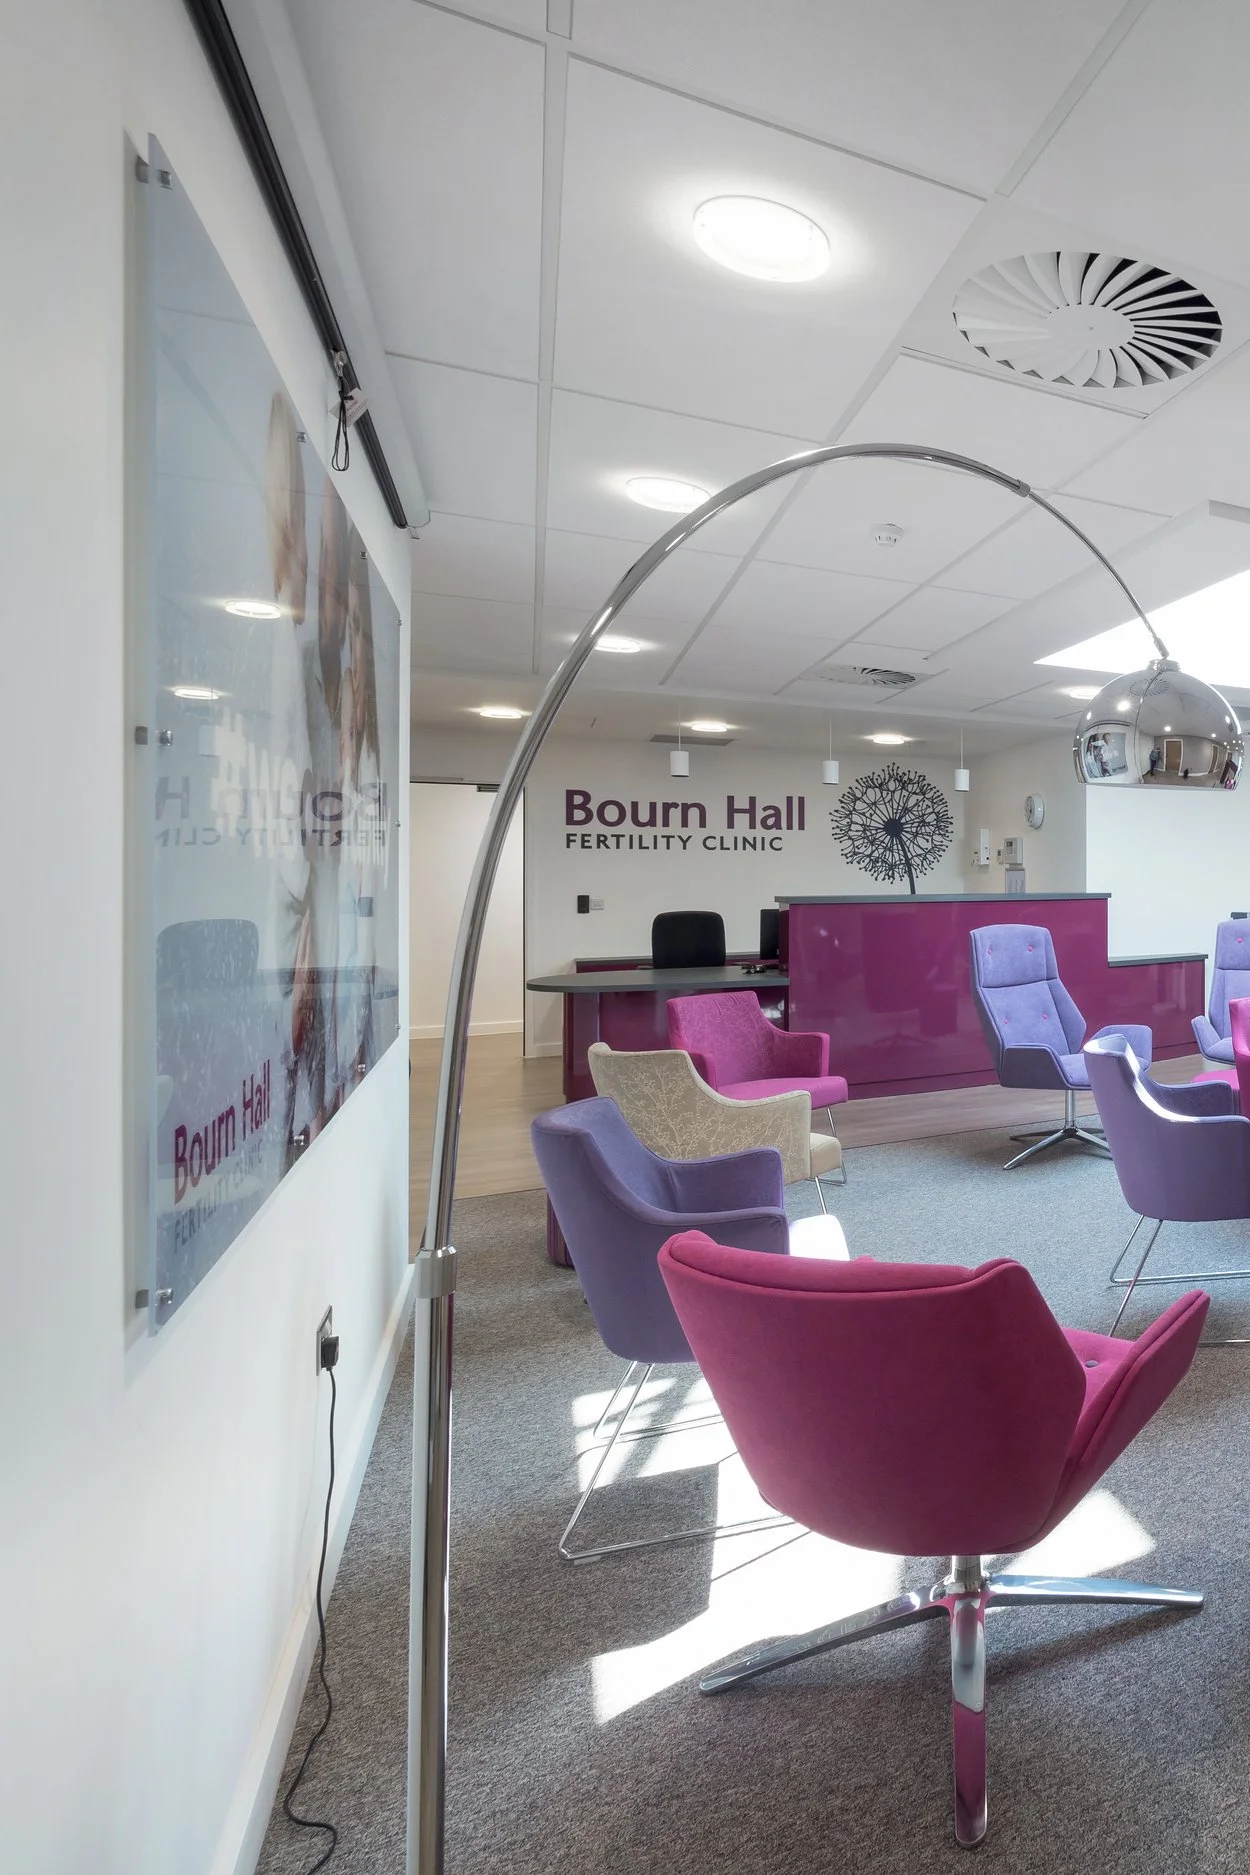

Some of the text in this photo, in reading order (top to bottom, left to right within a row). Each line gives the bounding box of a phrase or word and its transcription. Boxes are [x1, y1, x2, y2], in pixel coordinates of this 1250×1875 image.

[565, 789, 806, 831] Bourn Hall
[565, 833, 784, 852] FERTILITY CLINIC
[174, 1058, 270, 1206] Bourn Hall
[173, 1138, 264, 1255] FERTILITY CLINIC
